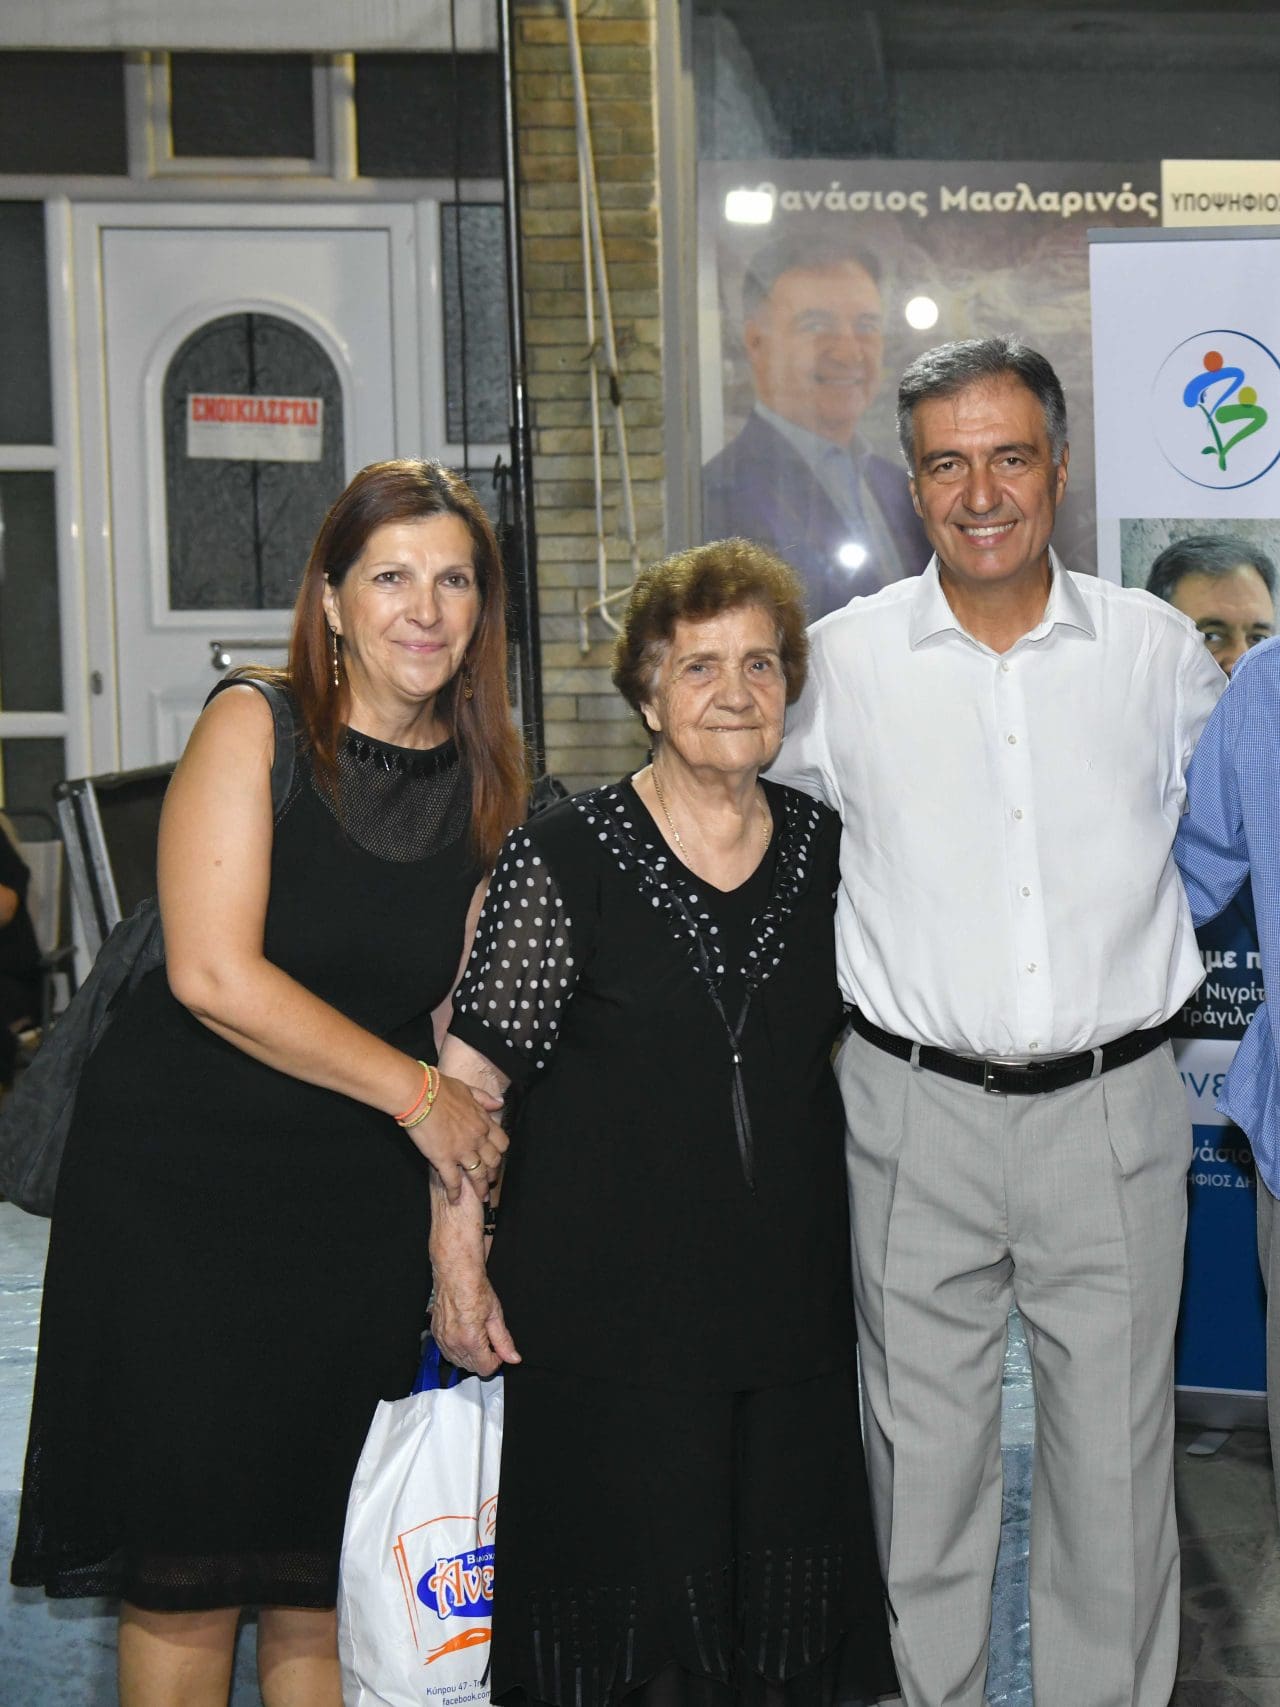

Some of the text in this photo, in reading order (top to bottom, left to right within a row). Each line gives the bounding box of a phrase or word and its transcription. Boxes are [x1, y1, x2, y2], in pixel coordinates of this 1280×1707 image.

[736, 181, 1159, 218] ανάσιος Μασλαρινός
[191, 396, 318, 426] ΕΝΟΙΚΙΑΖΕΤΑΙ
[1205, 981, 1266, 1004] Νιγρίτ
